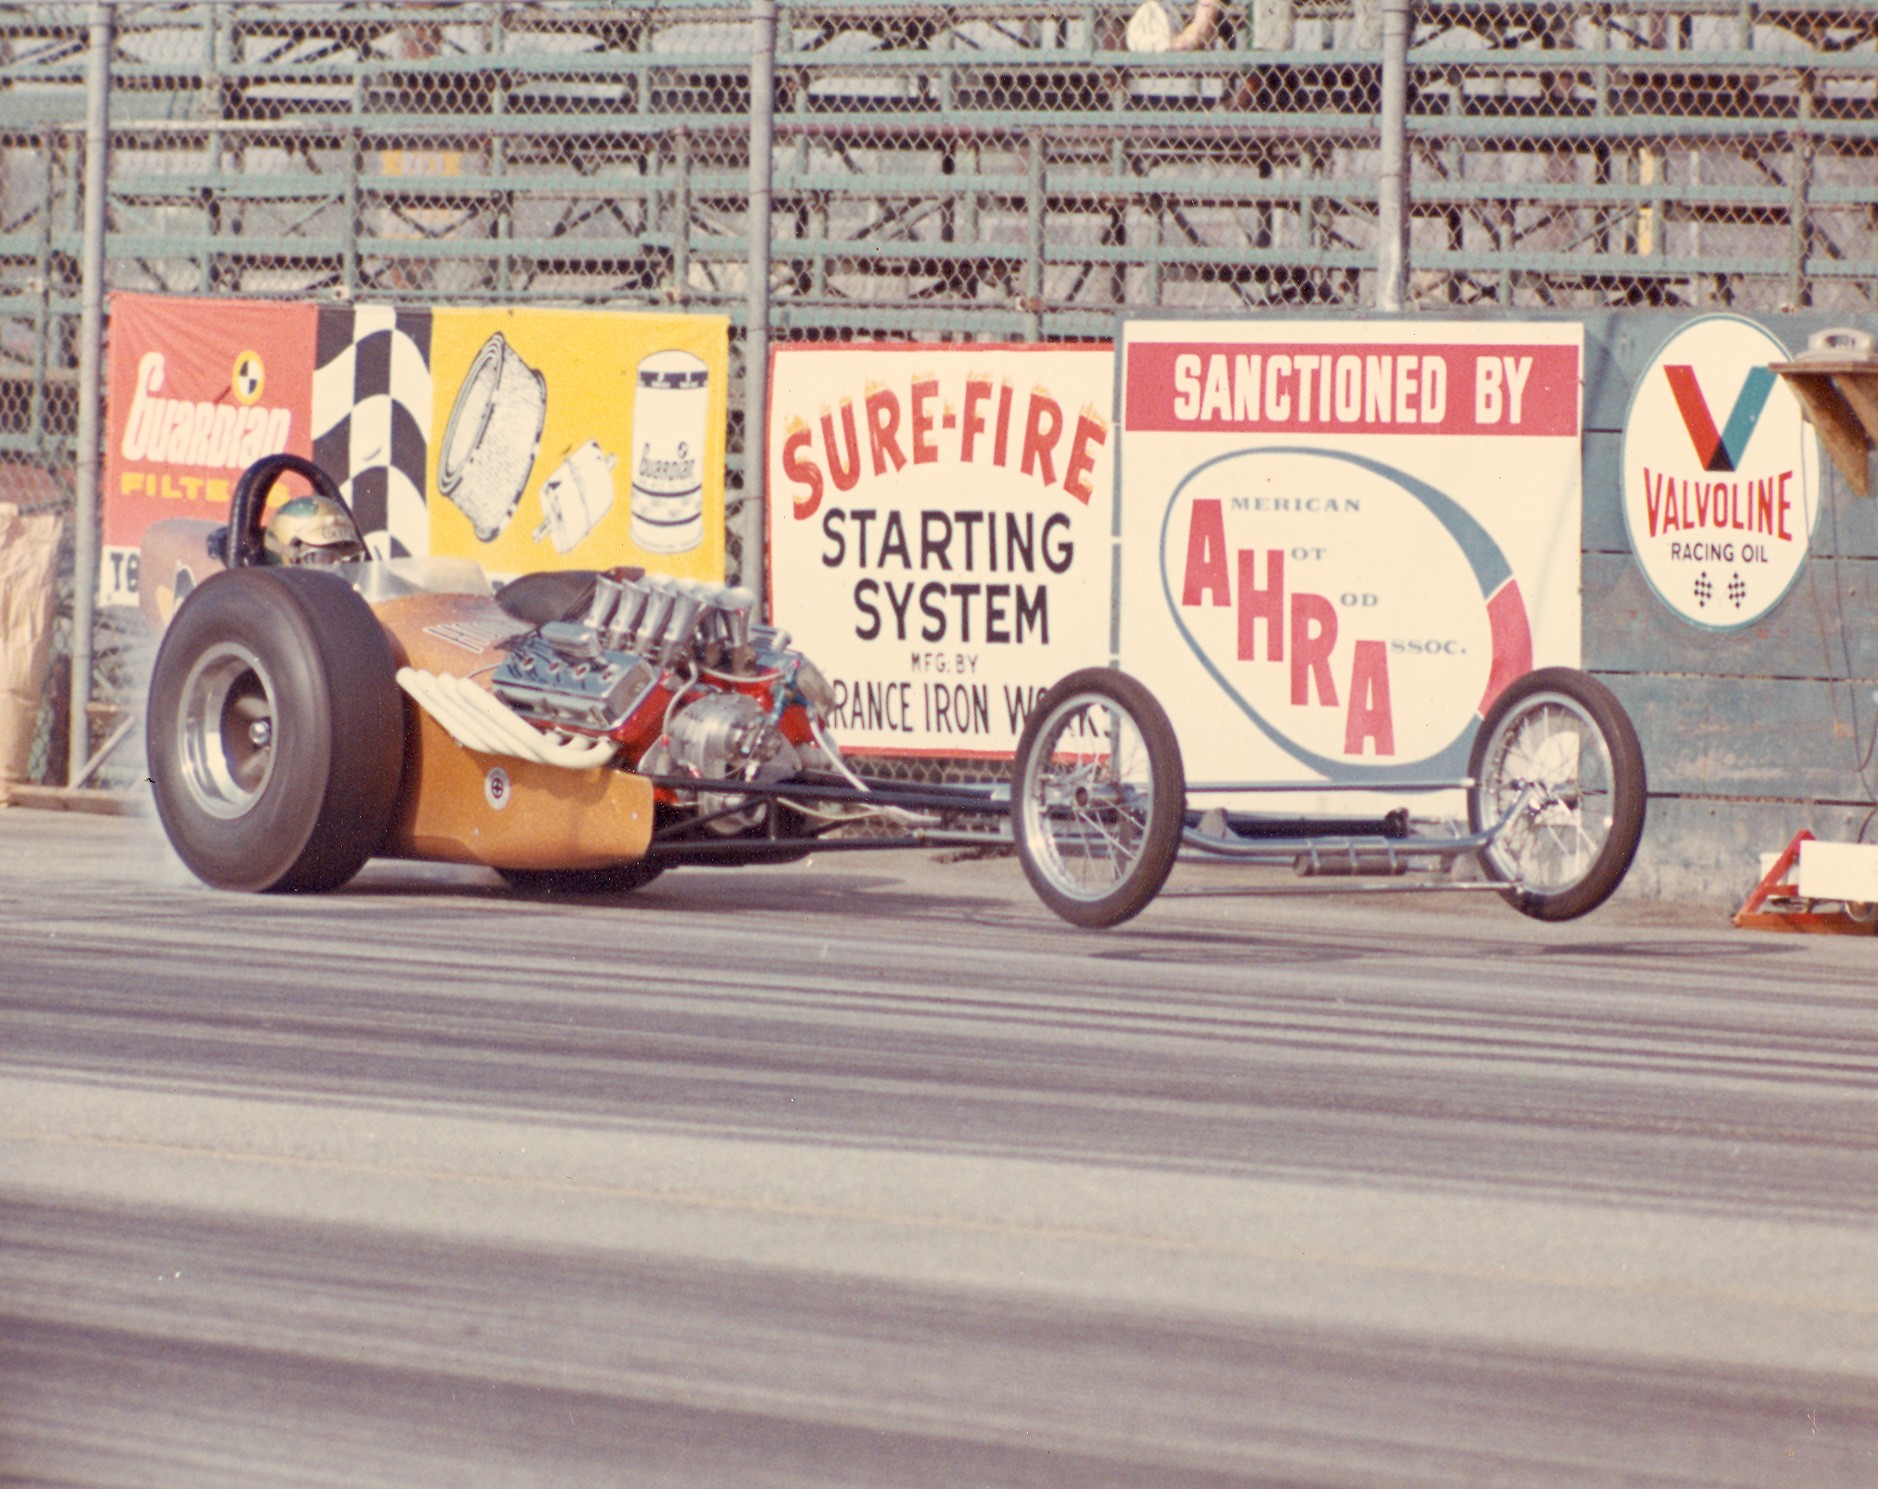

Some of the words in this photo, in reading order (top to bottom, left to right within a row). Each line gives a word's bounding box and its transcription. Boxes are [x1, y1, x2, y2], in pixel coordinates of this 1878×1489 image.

[1174, 353, 1448, 423] SANCTIONED
[1474, 356, 1533, 424] BY
[782, 374, 1108, 521] SURE-FIRE
[120, 472, 291, 509] FILTES
[1643, 467, 1793, 542] VALVOLINE
[822, 508, 1074, 574] STARTING
[1671, 542, 1734, 562] RACING
[1741, 544, 1769, 563] OIL
[854, 578, 1050, 645] SYSTEM
[911, 652, 950, 673] MFG.
[956, 653, 979, 674] BY
[826, 679, 914, 732] RANCE
[923, 683, 989, 735] IRON
